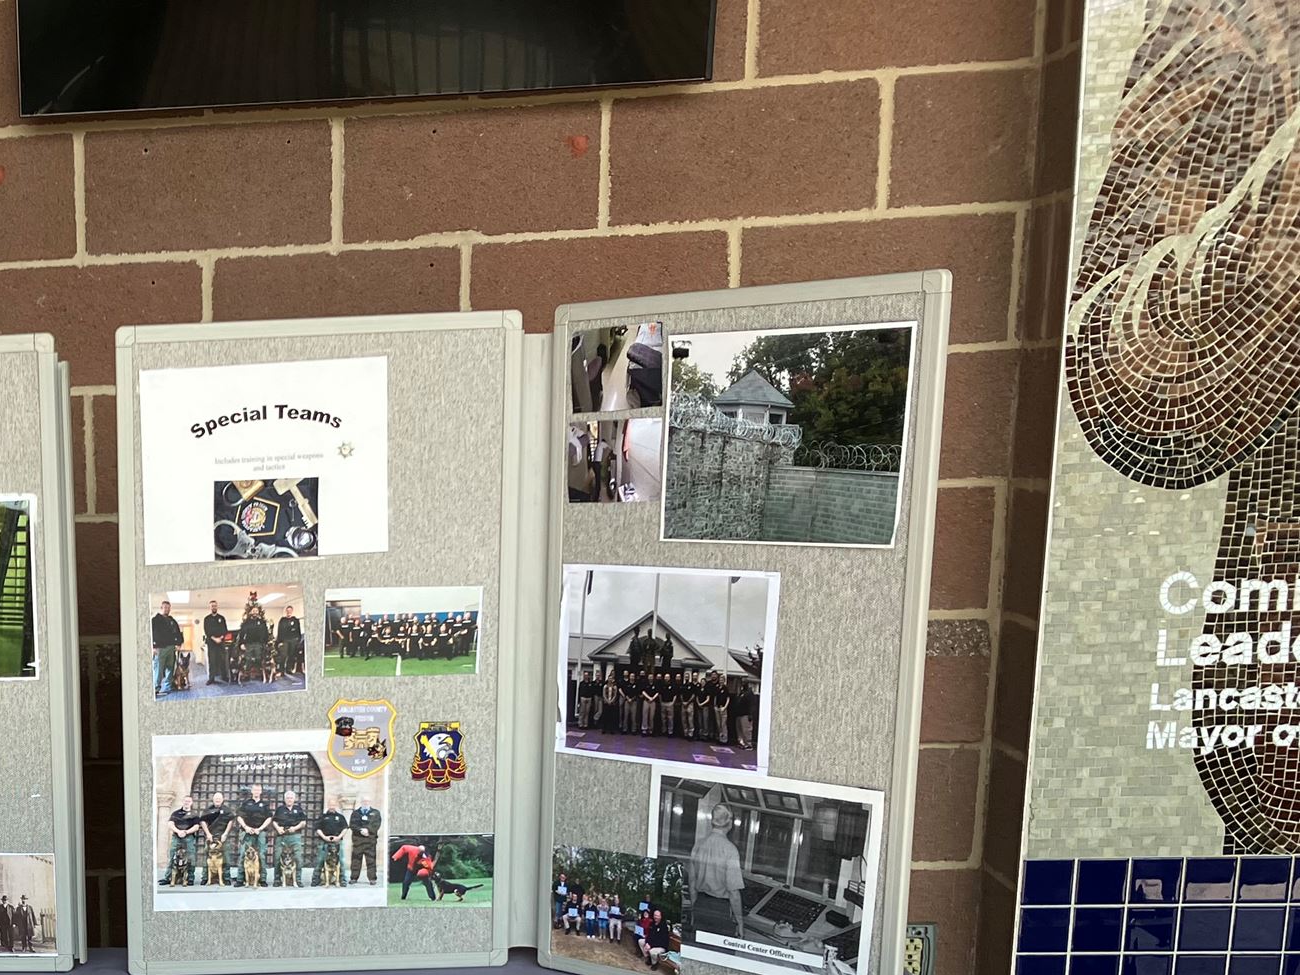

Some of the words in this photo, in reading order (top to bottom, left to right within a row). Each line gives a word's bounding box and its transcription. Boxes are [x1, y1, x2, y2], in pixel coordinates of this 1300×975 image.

[190, 405, 267, 439] Special
[274, 404, 343, 429] Teams
[1159, 570, 1300, 615] Com
[1156, 621, 1300, 666] Lead
[1150, 682, 1300, 711] Lancast
[1146, 720, 1263, 755] Mayor
[723, 939, 746, 950] Control
[747, 945, 768, 955] Center
[769, 949, 795, 960] Officers
